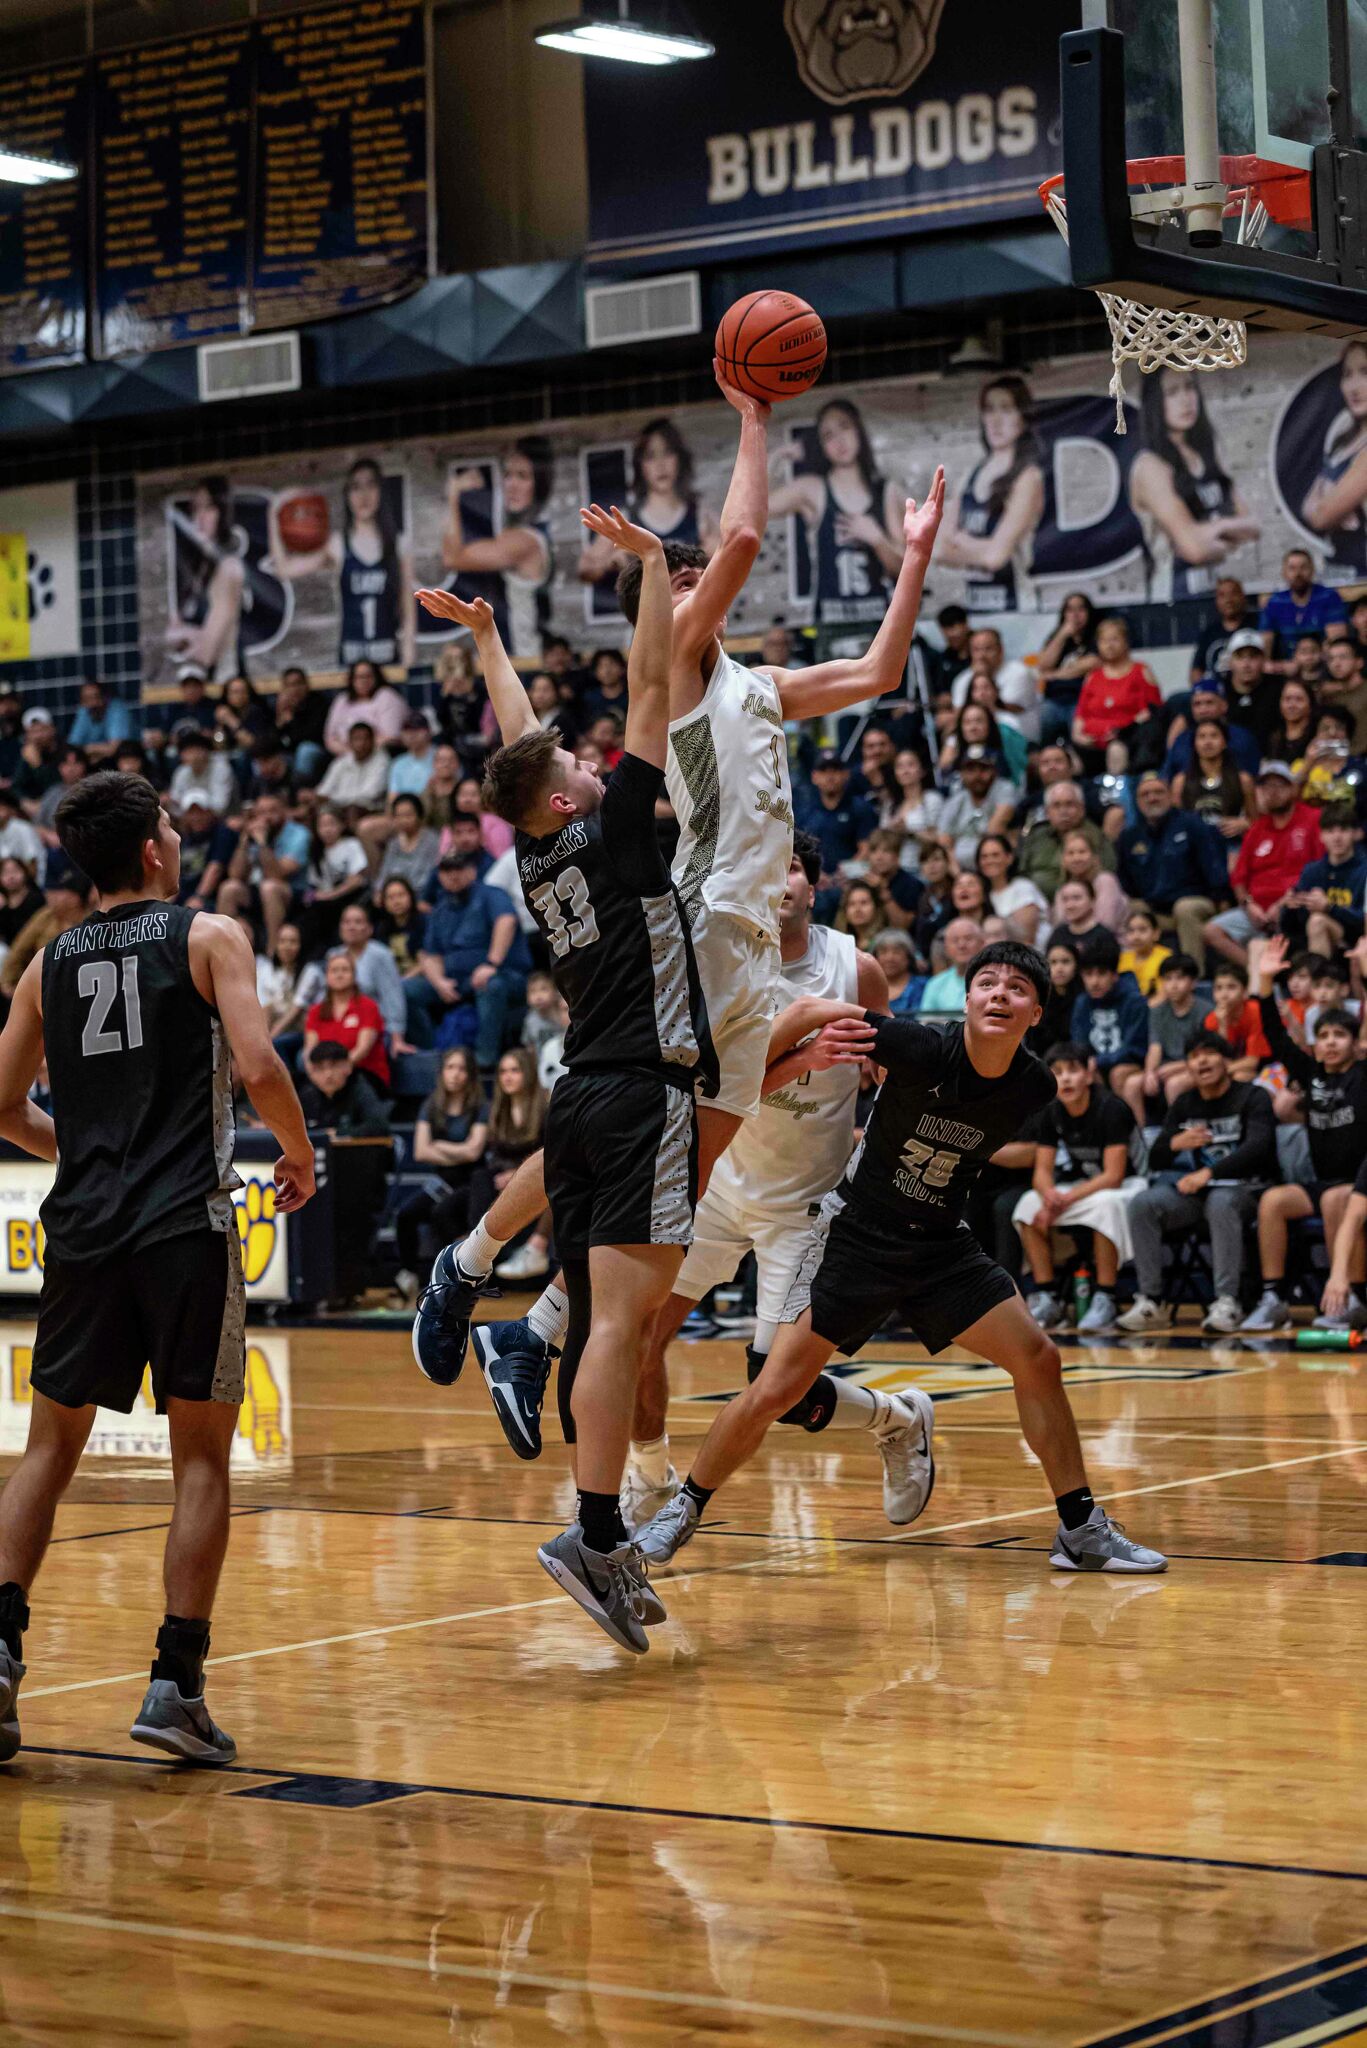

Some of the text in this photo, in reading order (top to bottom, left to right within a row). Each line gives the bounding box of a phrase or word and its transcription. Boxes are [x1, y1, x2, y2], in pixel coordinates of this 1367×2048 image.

[706, 86, 1037, 205] BULLDOGS
[54, 912, 169, 960] PANTHERS
[528, 865, 601, 958] 33
[77, 955, 144, 1057] 21
[915, 1113, 985, 1150] UNITED
